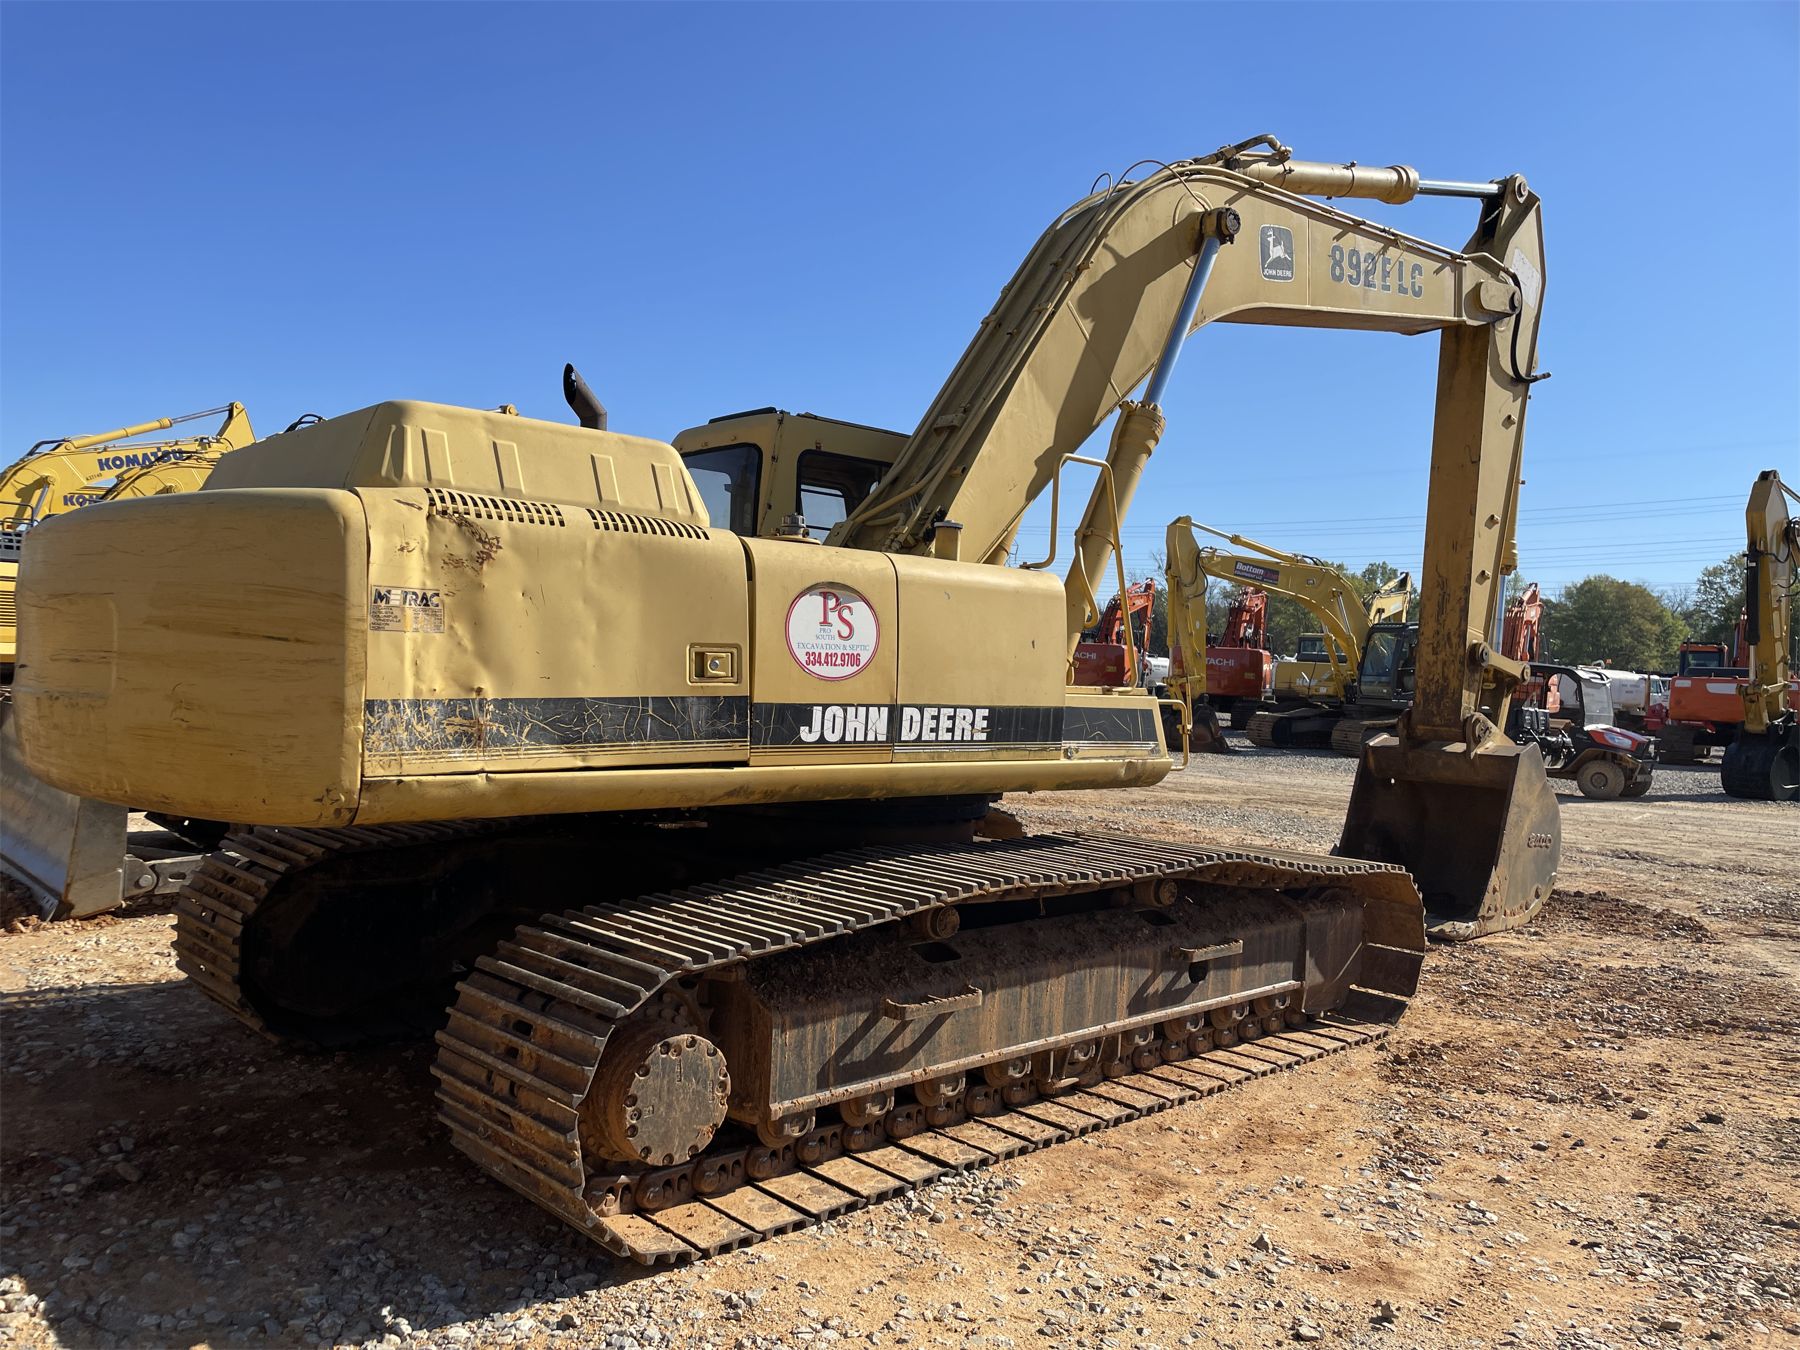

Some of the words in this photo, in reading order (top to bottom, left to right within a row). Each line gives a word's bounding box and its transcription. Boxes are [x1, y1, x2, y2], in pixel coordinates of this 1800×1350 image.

[1263, 268, 1276, 276] JOHN
[1276, 269, 1293, 278] DEERE
[797, 642, 841, 651] EXCAVATION
[848, 644, 870, 652] SEPTIC
[805, 651, 861, 667] 334.412.9706
[800, 705, 889, 743] JOHN
[900, 706, 990, 742] DEERE
